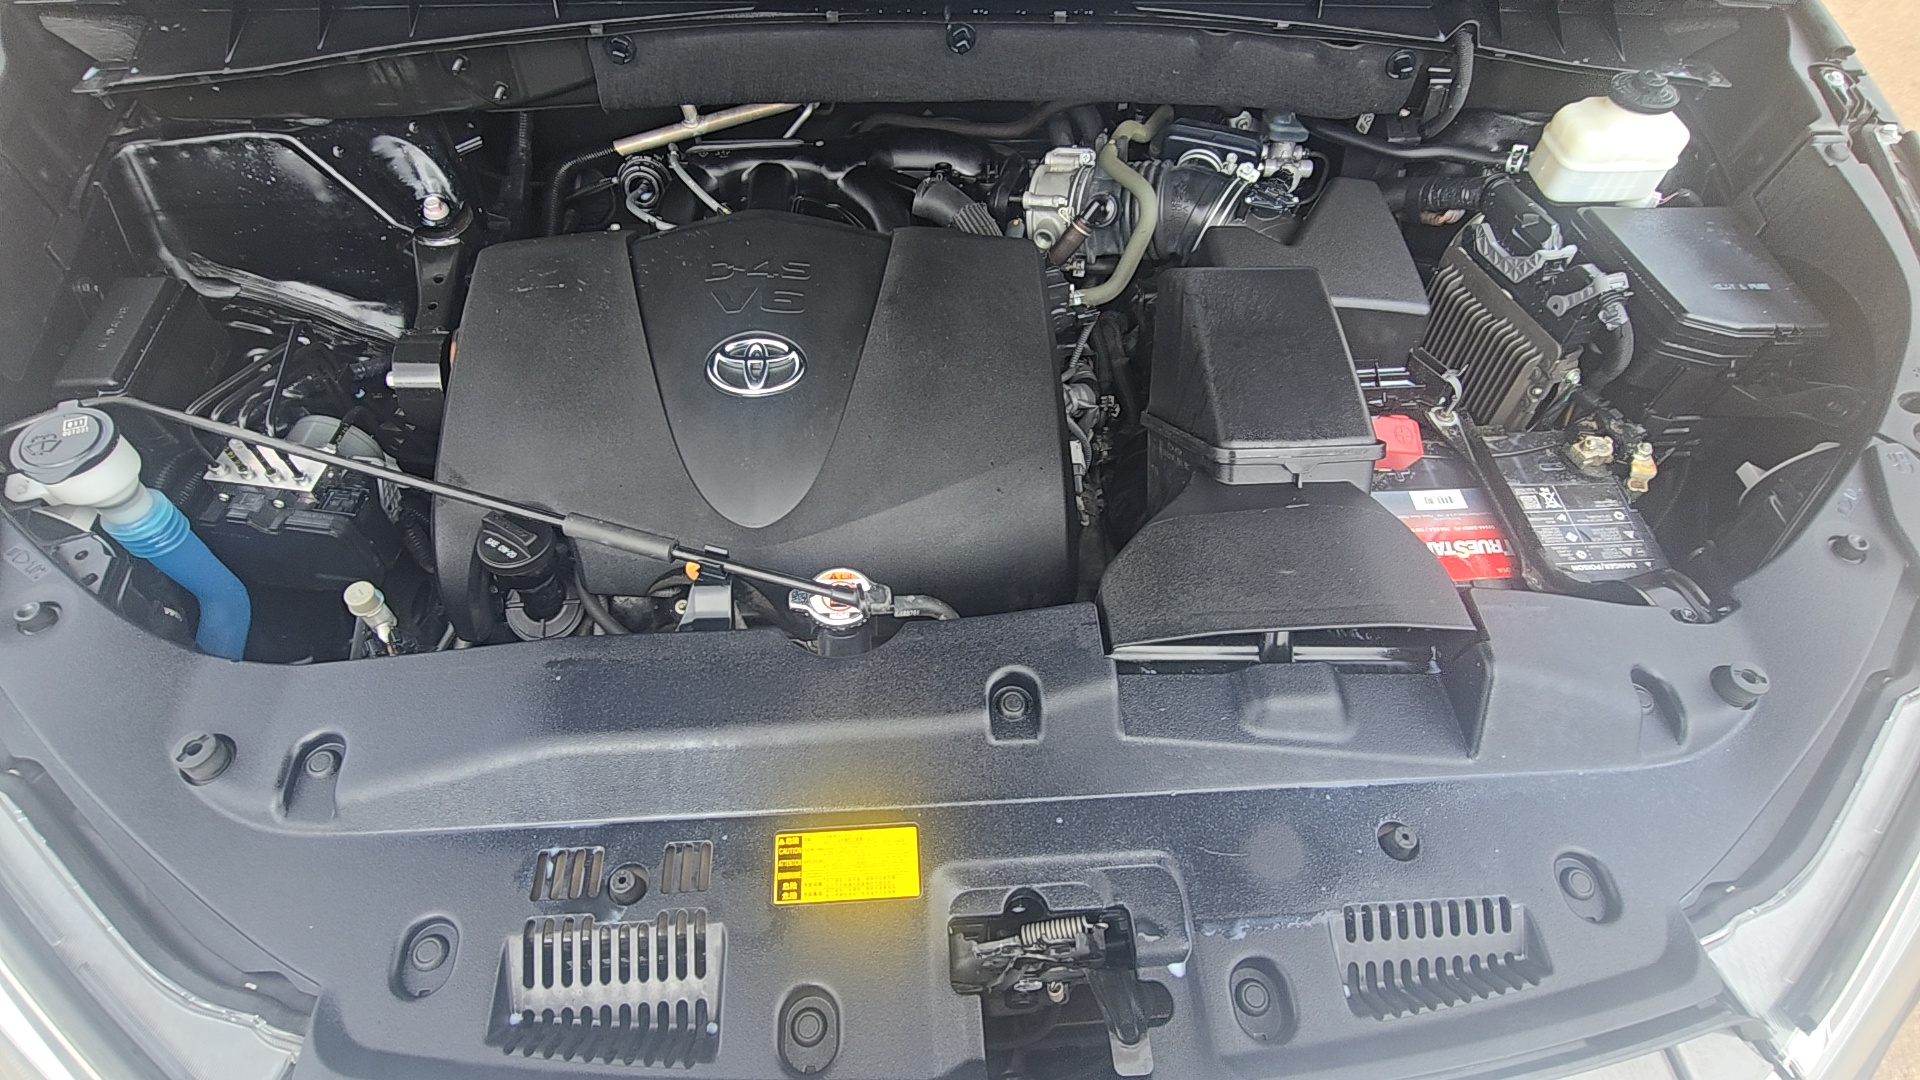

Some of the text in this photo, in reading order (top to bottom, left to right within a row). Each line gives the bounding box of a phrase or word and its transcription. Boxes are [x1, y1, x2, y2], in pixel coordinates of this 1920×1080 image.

[710, 288, 805, 314] V6
[485, 538, 500, 547] SAE
[1571, 562, 1638, 572] DANGER/POISON
[778, 847, 802, 855] CAUTION
